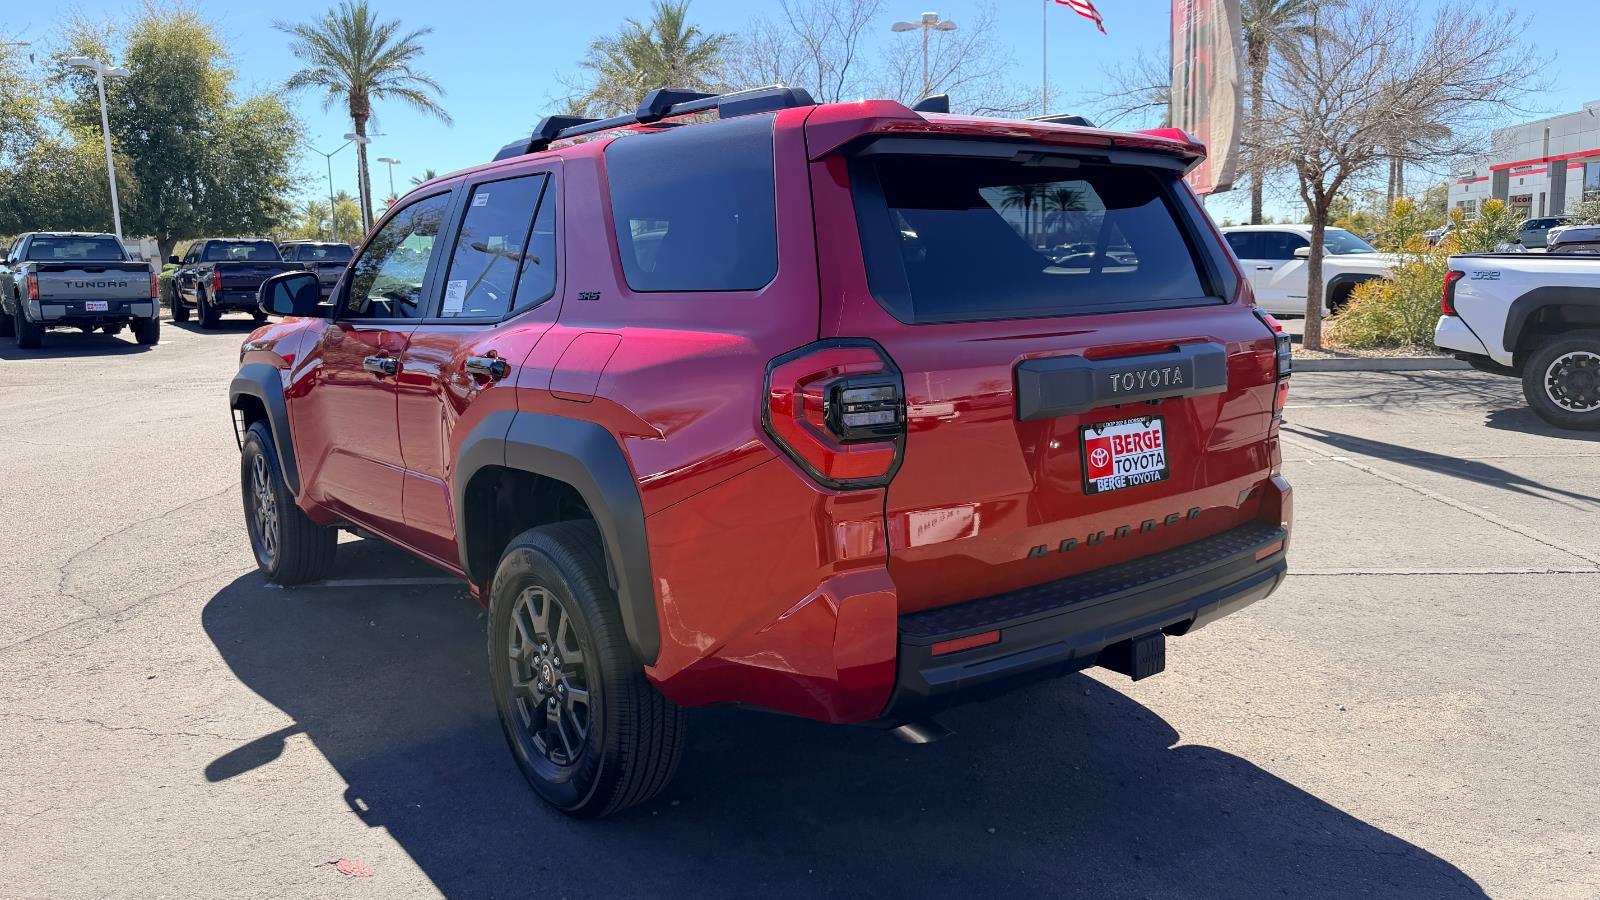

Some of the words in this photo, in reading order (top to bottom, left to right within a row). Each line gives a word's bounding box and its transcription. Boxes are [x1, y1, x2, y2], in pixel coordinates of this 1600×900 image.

[1110, 366, 1183, 391] TOYOTA
[1112, 429, 1161, 455] BERGE
[1115, 452, 1164, 473] TOYOTA
[1097, 476, 1127, 492] BERGE
[1127, 471, 1160, 486] TOYOTA
